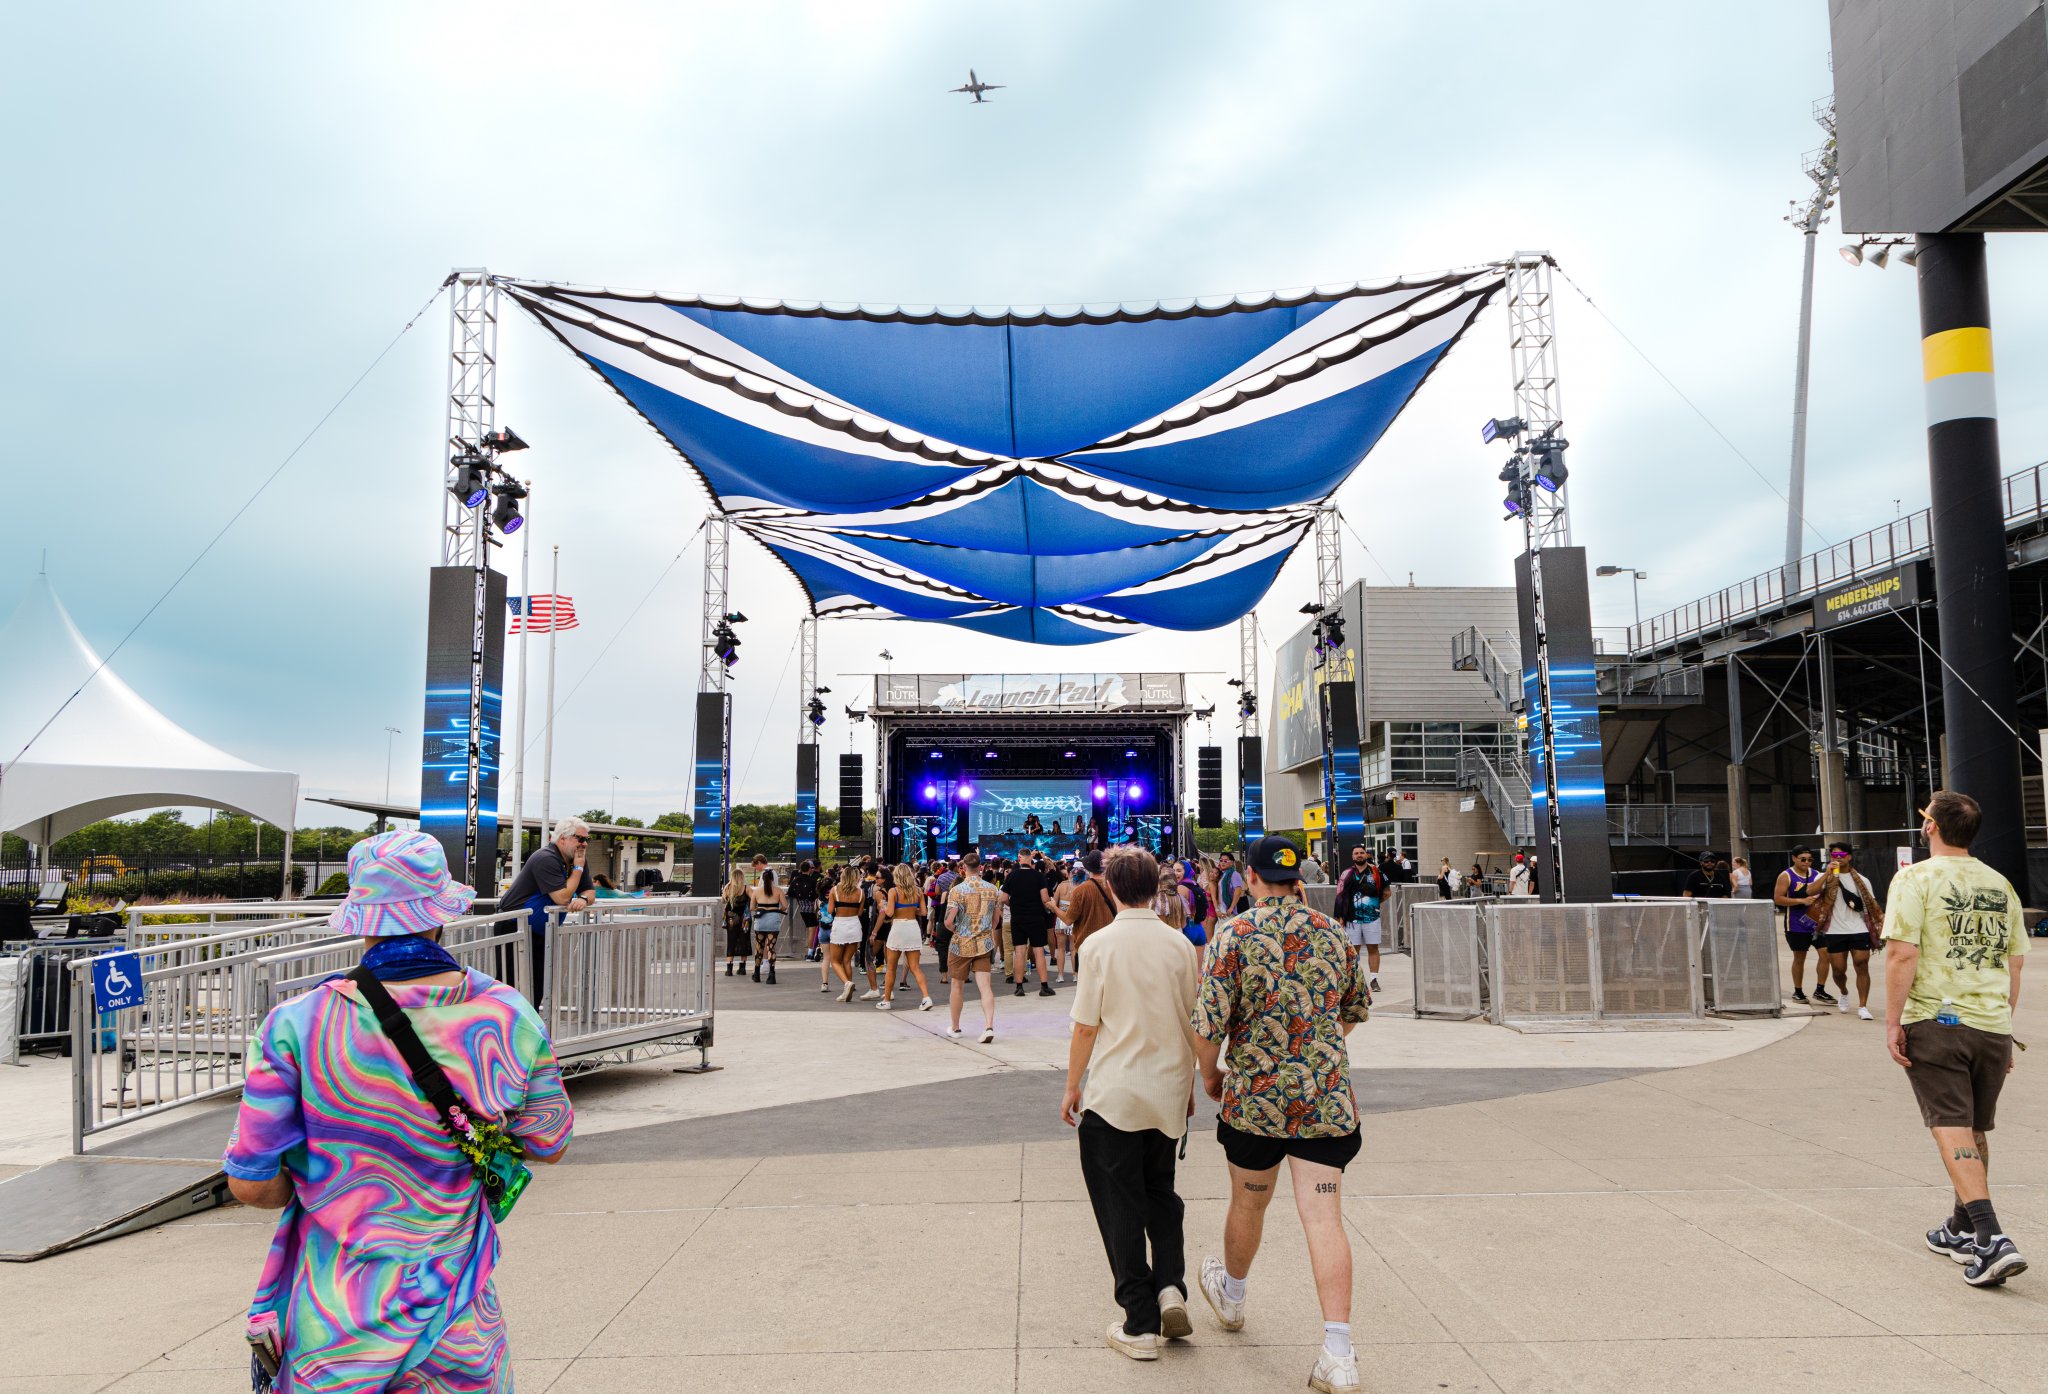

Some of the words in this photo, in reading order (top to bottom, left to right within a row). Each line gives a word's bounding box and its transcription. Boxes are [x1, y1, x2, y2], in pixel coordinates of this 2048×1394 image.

[1826, 577, 1900, 612] MEMBERSHIPS
[1838, 598, 1889, 621] 614.447.CREW
[967, 684, 1051, 708] Launch
[1050, 678, 1114, 704] Pad
[1980, 937, 1993, 947] Co.
[109, 996, 131, 1007] ONLY
[1315, 1182, 1337, 1193] 4969
